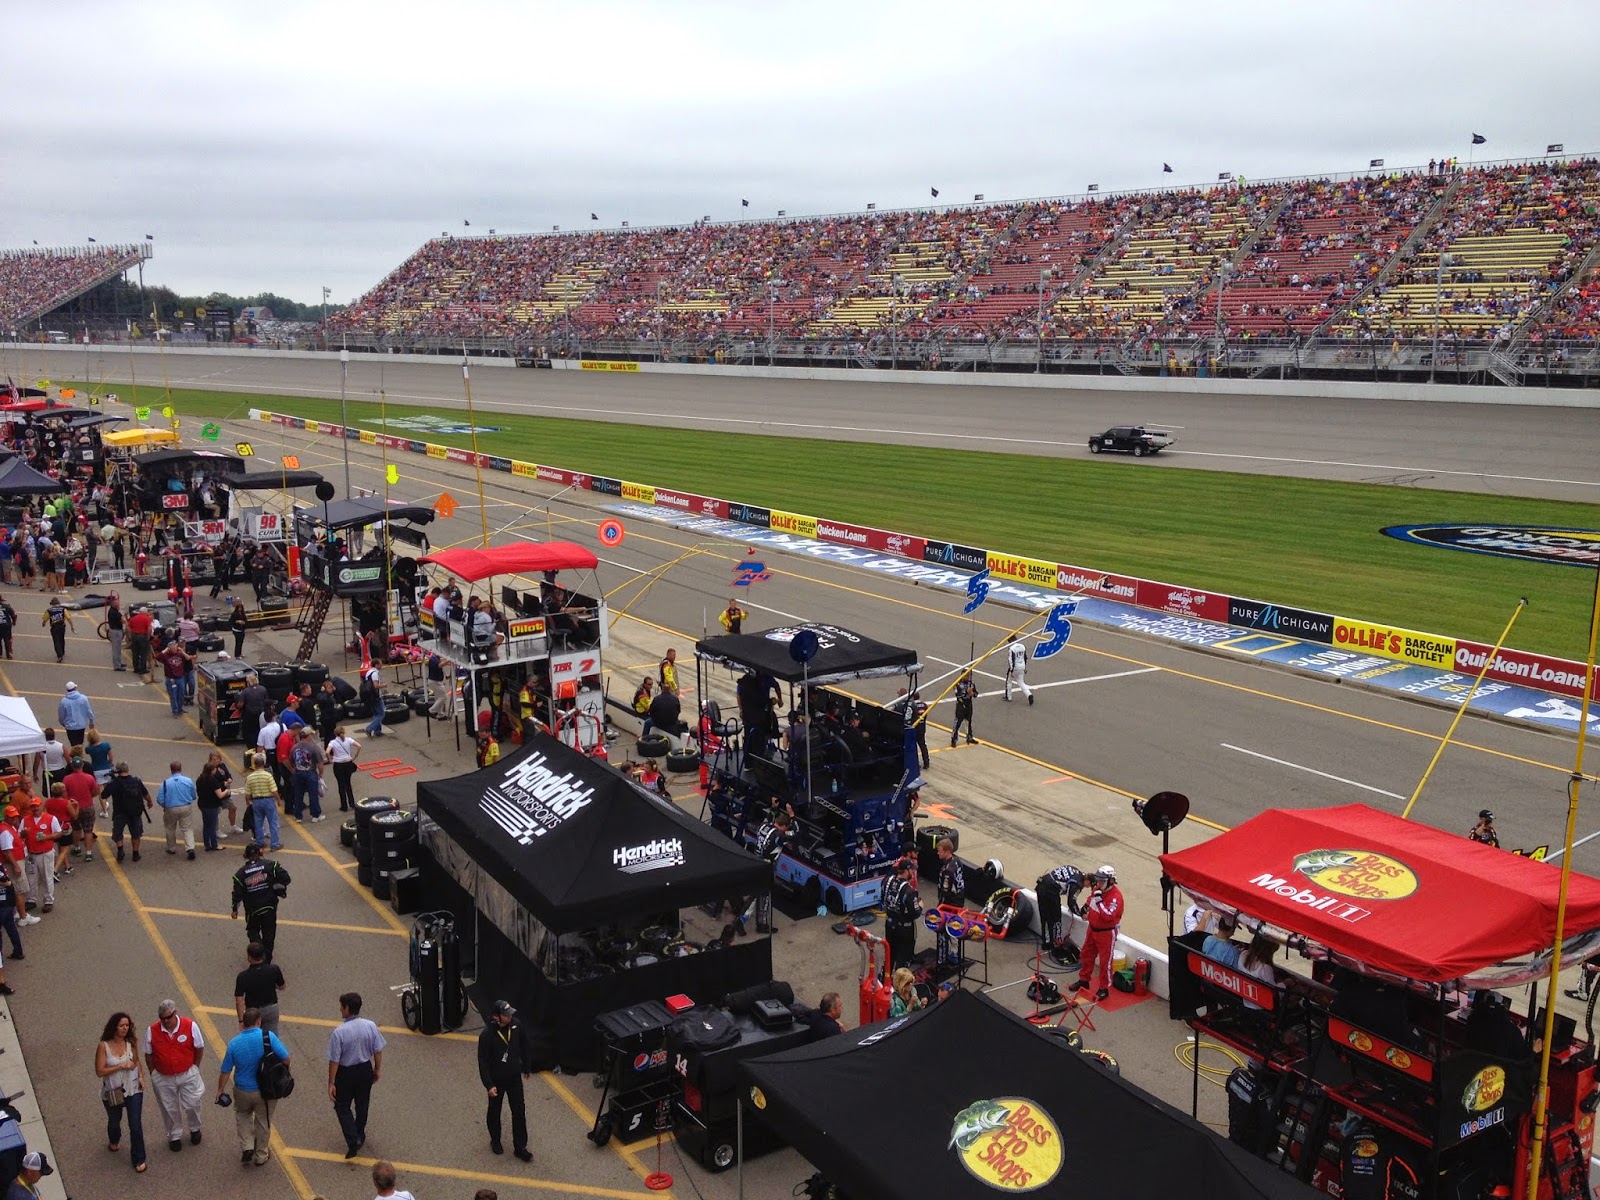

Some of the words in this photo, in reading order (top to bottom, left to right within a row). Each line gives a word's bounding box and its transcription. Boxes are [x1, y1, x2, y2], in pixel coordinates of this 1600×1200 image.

[236, 442, 254, 456] 31
[282, 455, 300, 469] 18
[163, 495, 188, 507] 3M
[260, 515, 277, 529] 98
[729, 508, 742, 517] PURE
[201, 522, 224, 534] 3M
[797, 519, 816, 529] BARGAIN
[797, 526, 814, 535] OUTLET
[817, 524, 845, 538] Quicken
[844, 529, 867, 543] Loans
[925, 547, 943, 557] PURE
[1027, 572, 1052, 584] OUTLET
[1028, 565, 1056, 577] BARGAIN
[1057, 571, 1103, 591] Quicken
[963, 568, 990, 616] 5
[1232, 606, 1259, 620] PURE
[1250, 605, 1328, 633] MICHIGAN
[1031, 599, 1080, 660] 5
[1405, 637, 1453, 655] BARGAIN
[1405, 647, 1445, 664] OUTLET
[1455, 647, 1532, 677] Quicken
[1530, 662, 1590, 690] Loans
[1399, 673, 1465, 693] SOUTH
[500, 750, 595, 820] Hendrick
[502, 784, 562, 830] MOTORSPORTS
[613, 838, 683, 868] Hendrick
[627, 850, 684, 867] MOTORSPORTS
[1342, 865, 1381, 883] Pro
[1355, 853, 1404, 880] Bass
[1328, 873, 1390, 899] Shops
[1248, 873, 1339, 911] Mobil
[1339, 905, 1353, 919] 1
[1200, 959, 1240, 993] Mobil
[675, 1053, 688, 1078] 14
[1482, 1069, 1498, 1082] Bass
[1479, 1081, 1494, 1094] Pro
[1480, 1089, 1502, 1106] Shops
[628, 1111, 643, 1131] 5
[1005, 1104, 1052, 1146] Bass
[1460, 1112, 1493, 1138] Mobil
[992, 1125, 1028, 1158] Pro
[978, 1140, 1033, 1188] Shops
